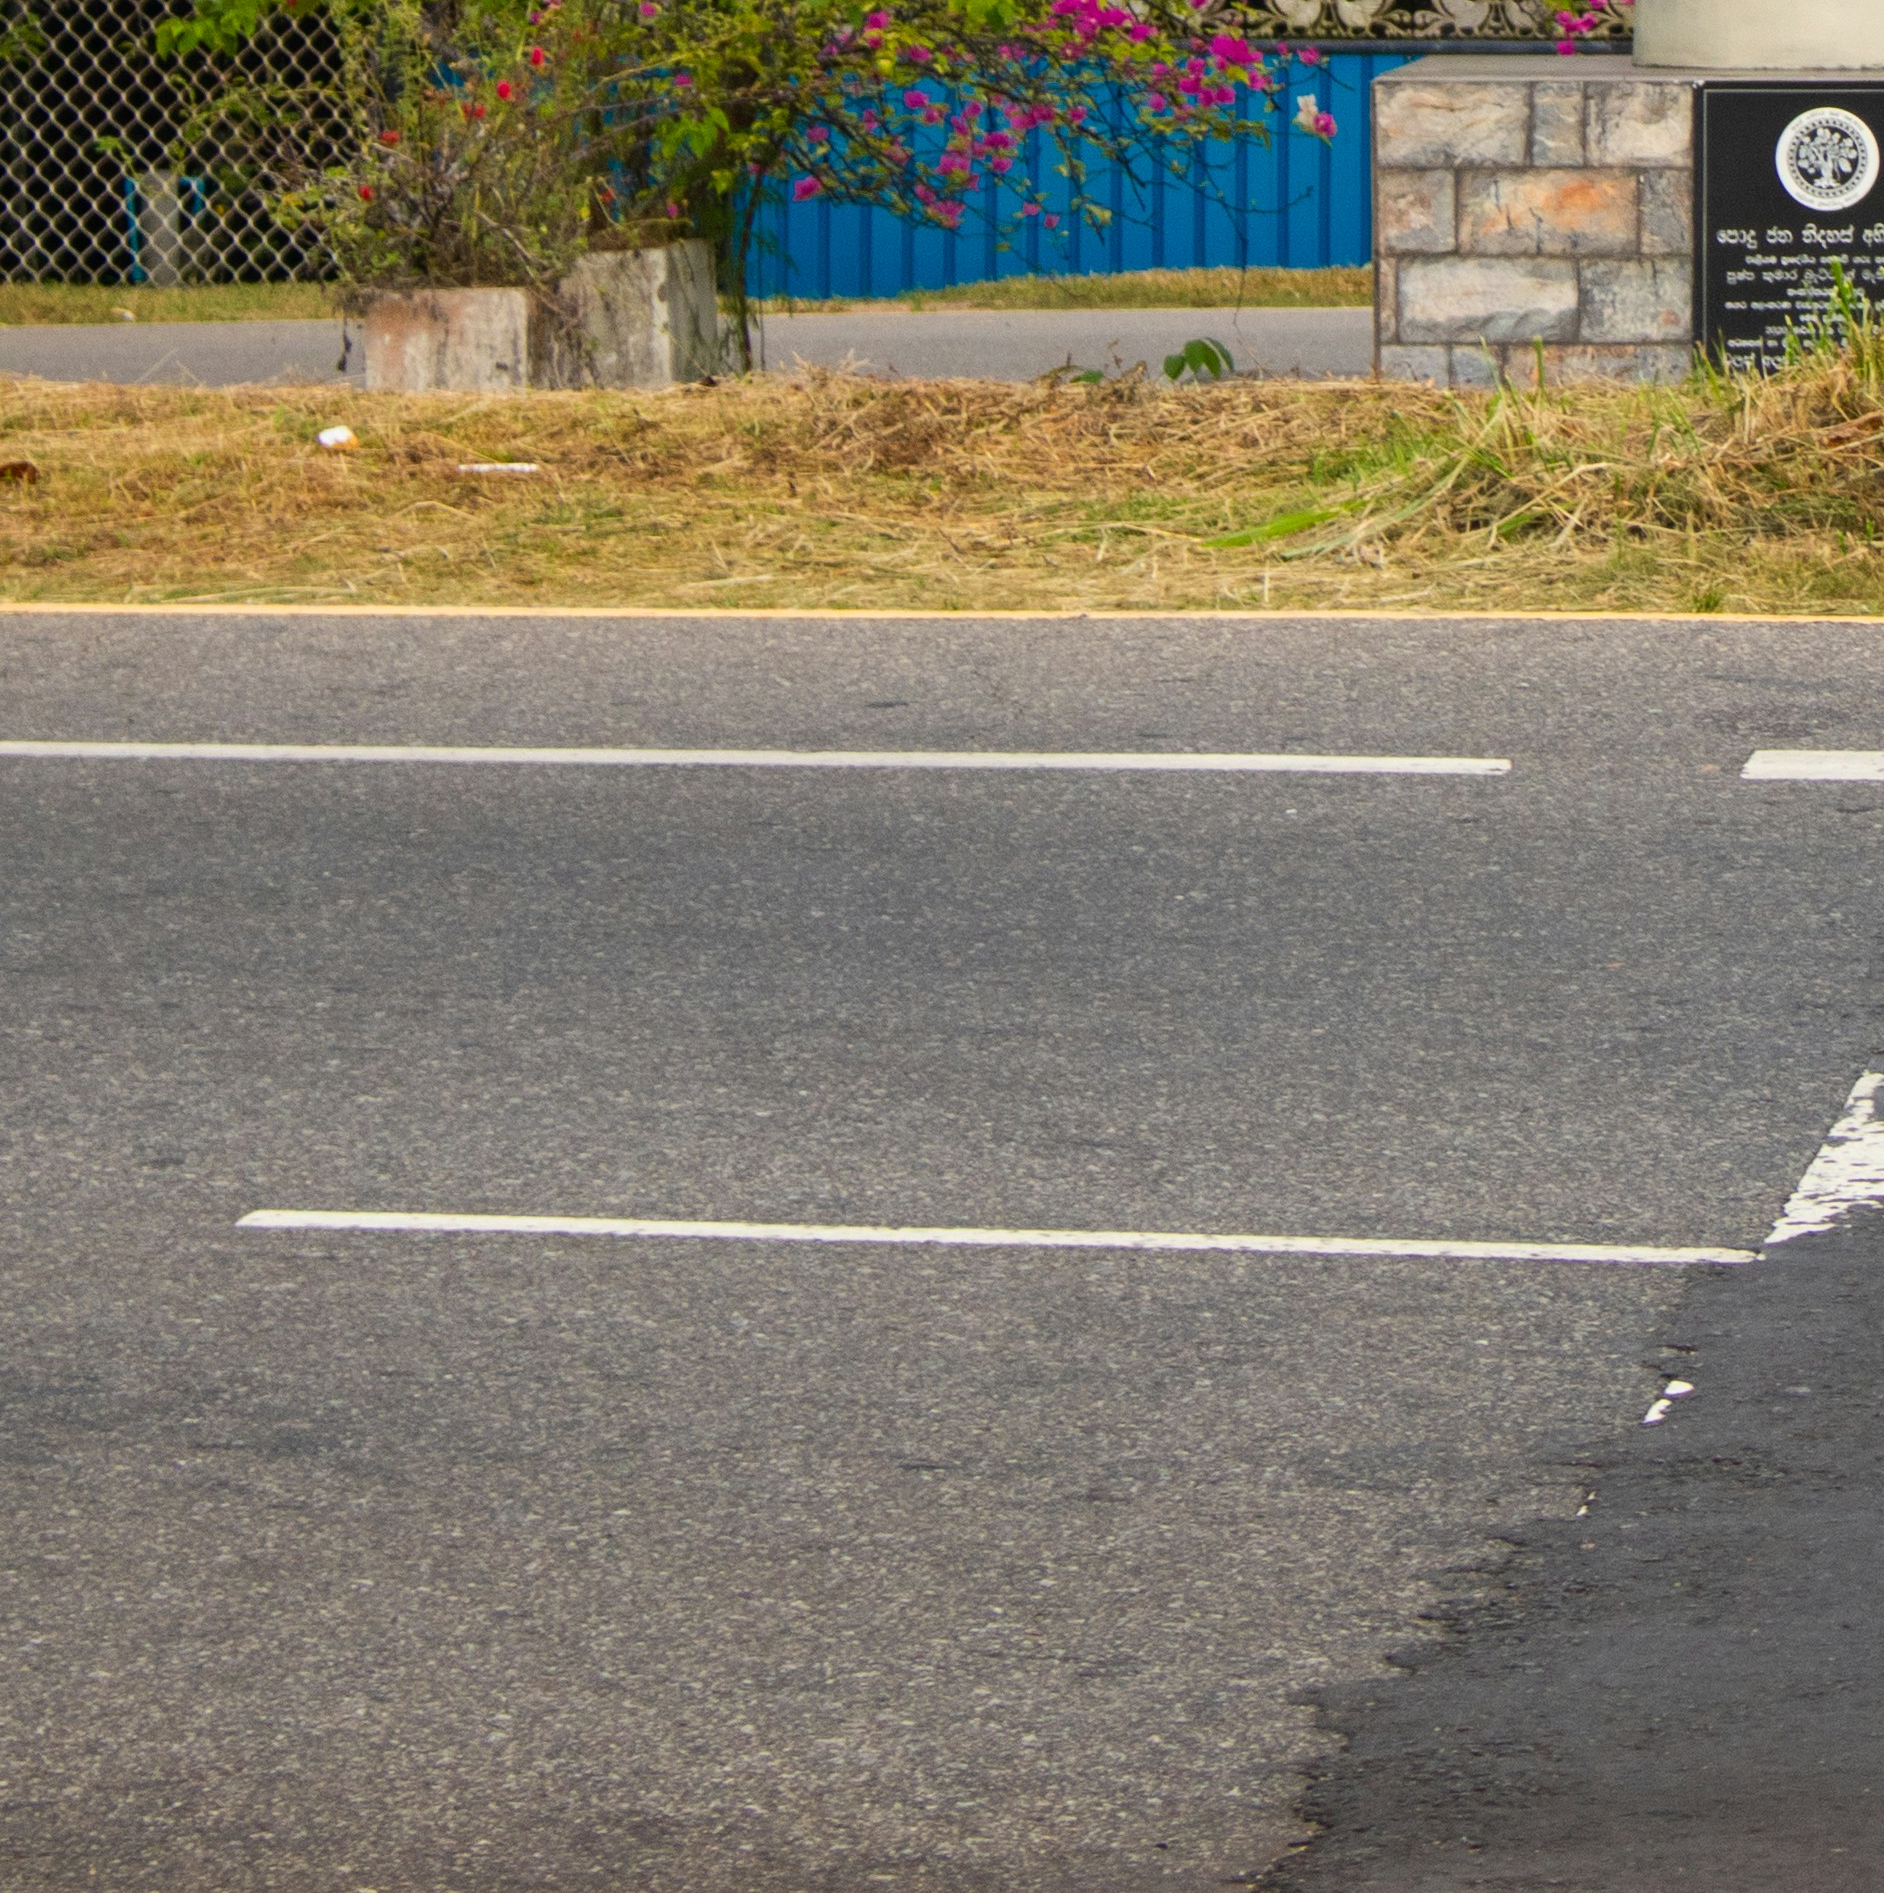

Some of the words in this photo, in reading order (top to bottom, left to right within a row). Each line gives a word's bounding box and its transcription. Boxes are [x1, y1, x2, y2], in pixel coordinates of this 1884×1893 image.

[1716, 228, 1758, 249] පොදු
[1766, 226, 1794, 244] ජන
[1801, 222, 1855, 249] නිදහස්
